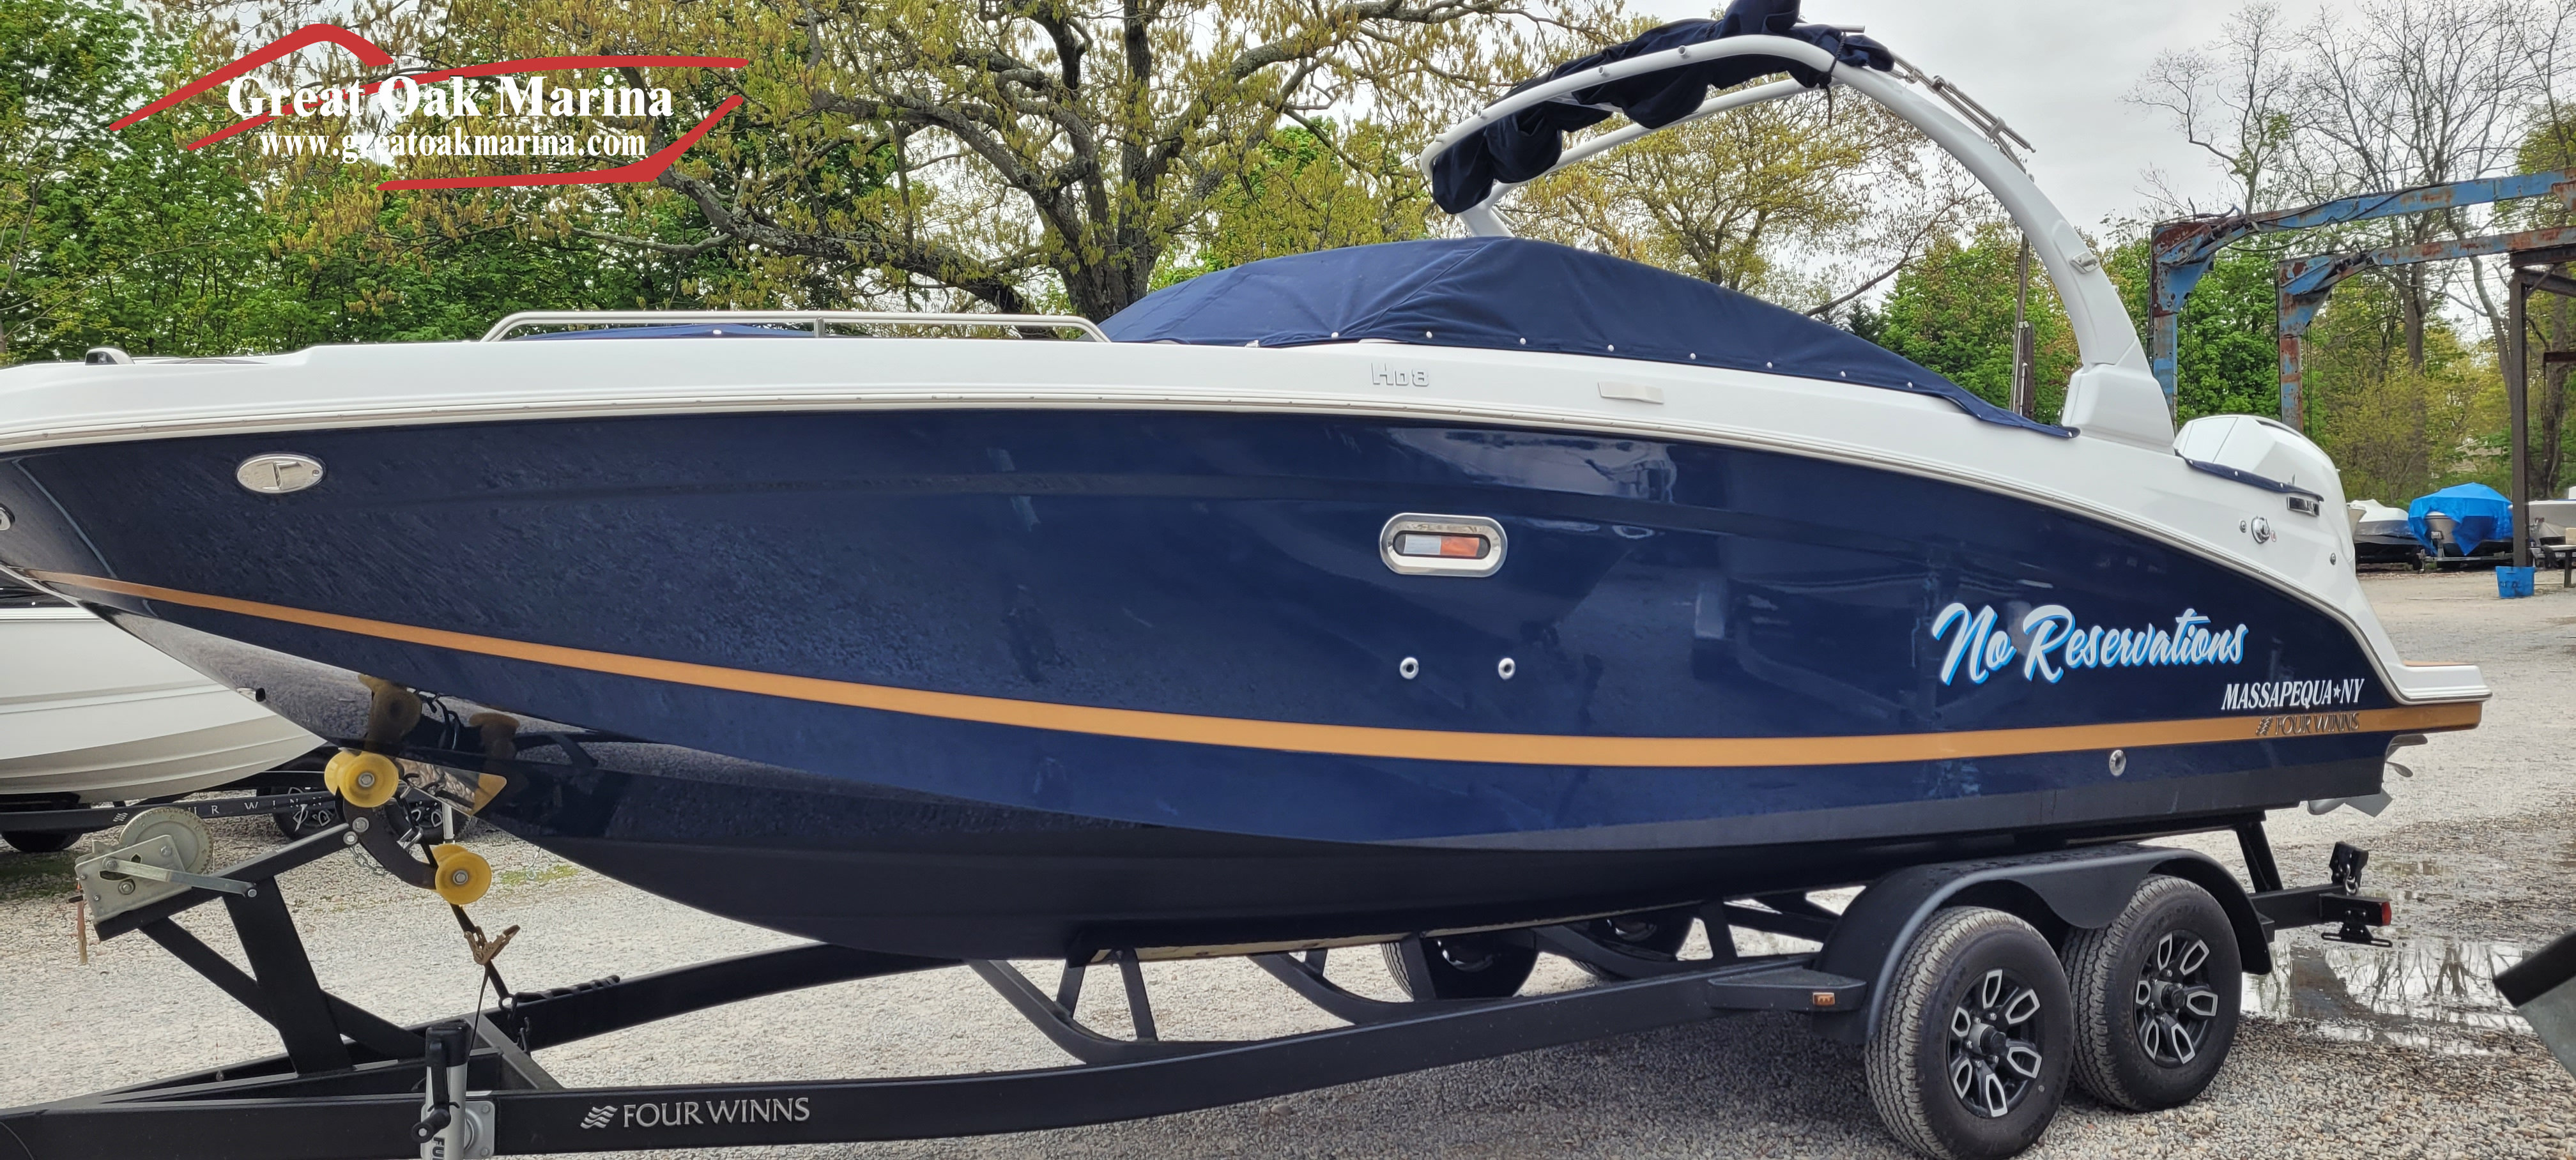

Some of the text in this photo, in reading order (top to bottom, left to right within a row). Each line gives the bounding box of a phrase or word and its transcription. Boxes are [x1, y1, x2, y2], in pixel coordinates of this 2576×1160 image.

[1933, 602, 2249, 686] No Reservations
[2275, 712, 2359, 735] FOUR WINNS
[623, 1097, 810, 1127] FOUR WINNS
